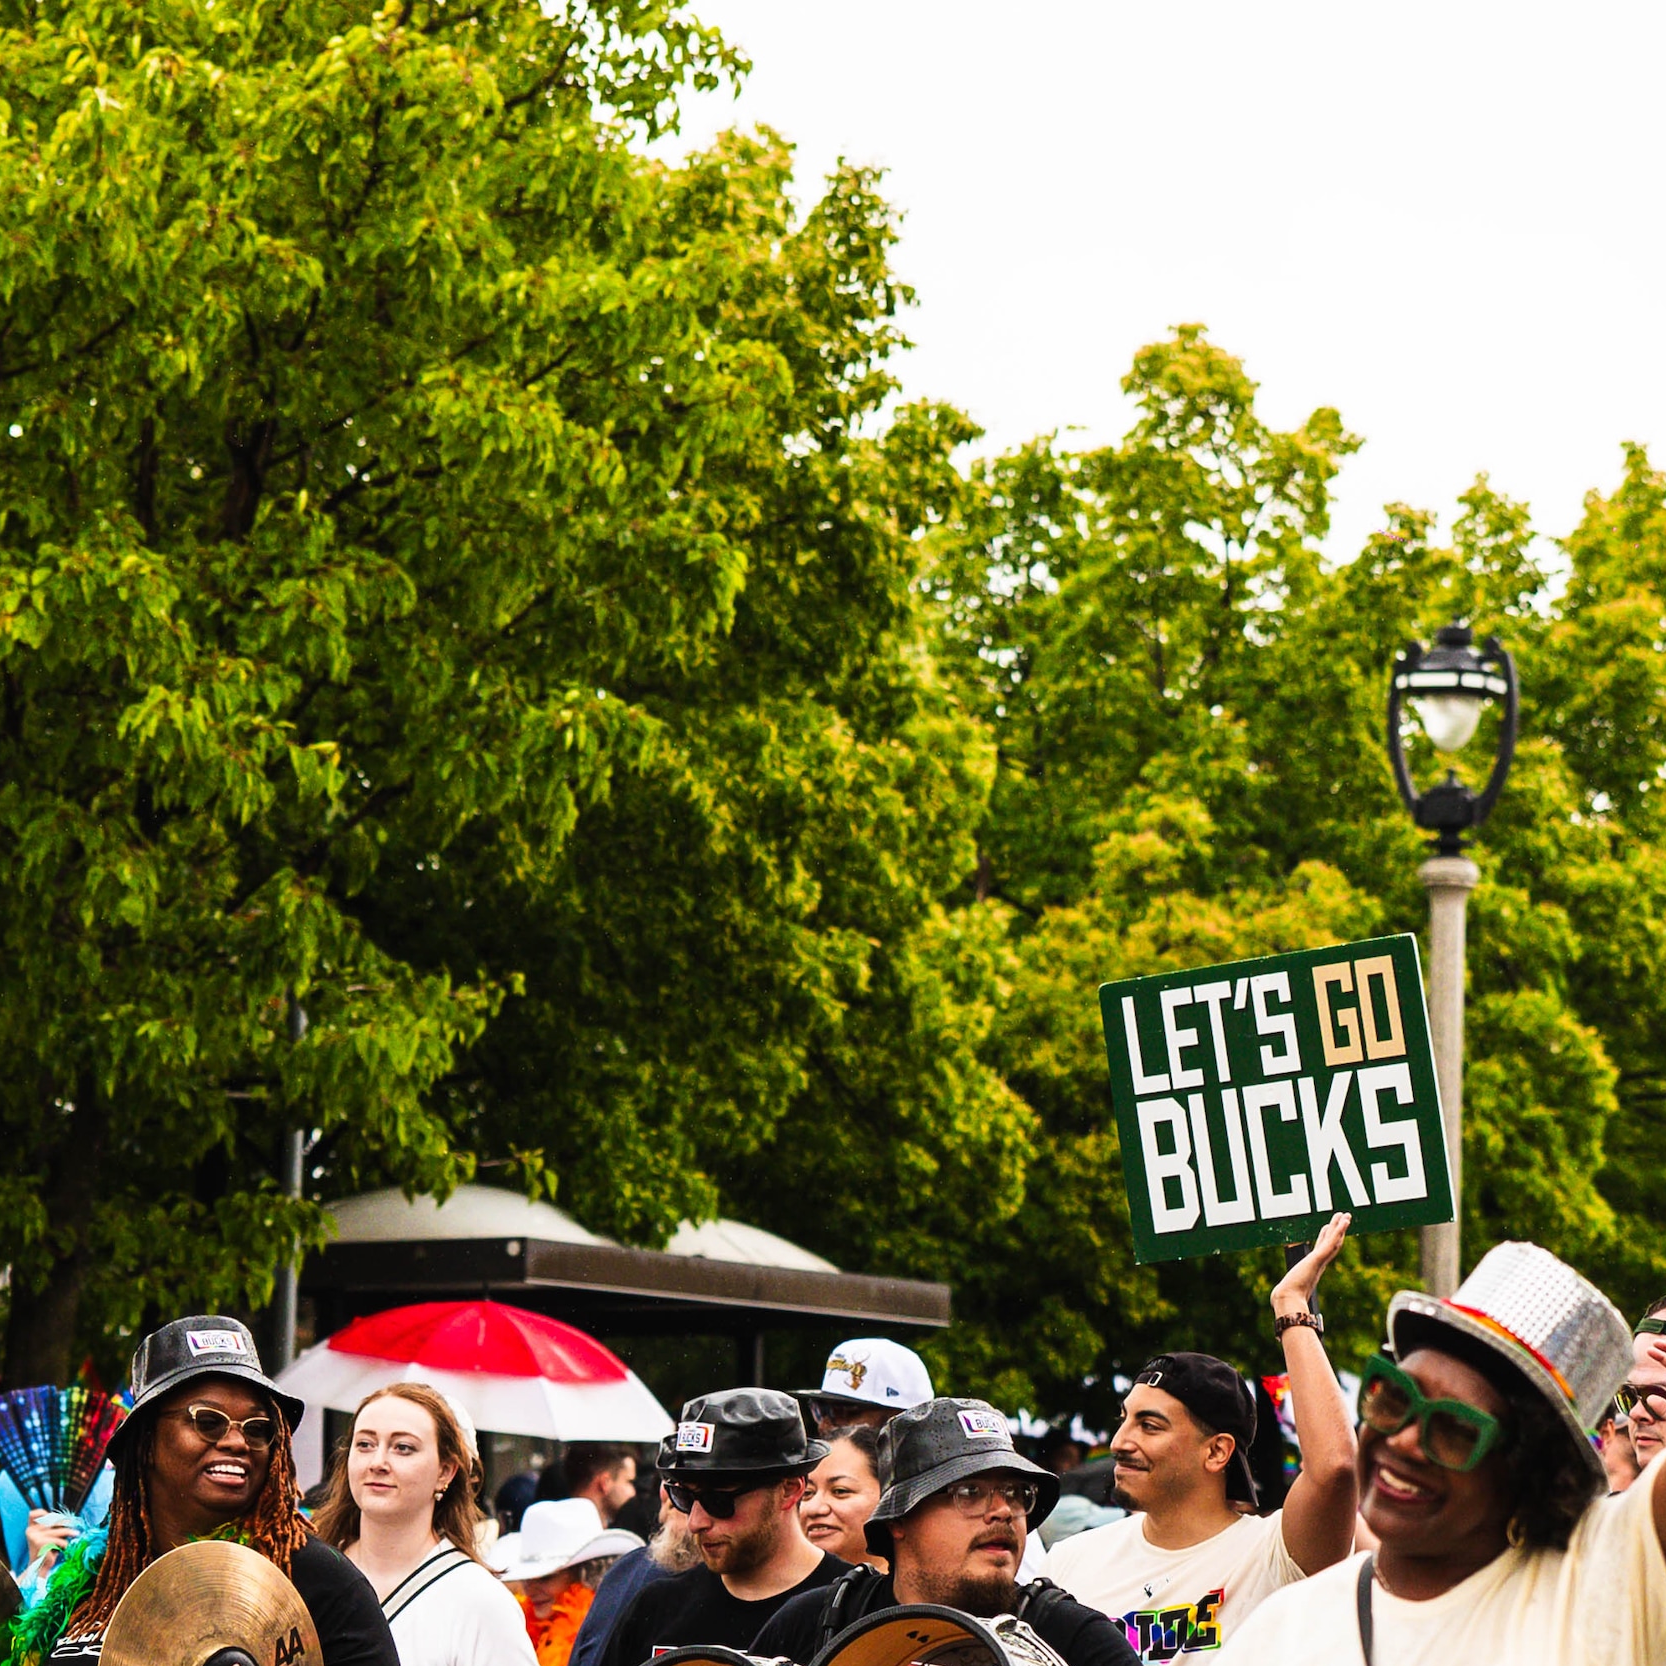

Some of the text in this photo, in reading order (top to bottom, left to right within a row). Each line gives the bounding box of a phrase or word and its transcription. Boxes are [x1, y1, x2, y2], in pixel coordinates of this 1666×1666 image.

[1120, 954, 1407, 1096] LET'S GO
[1135, 1061, 1428, 1235] BUCKS
